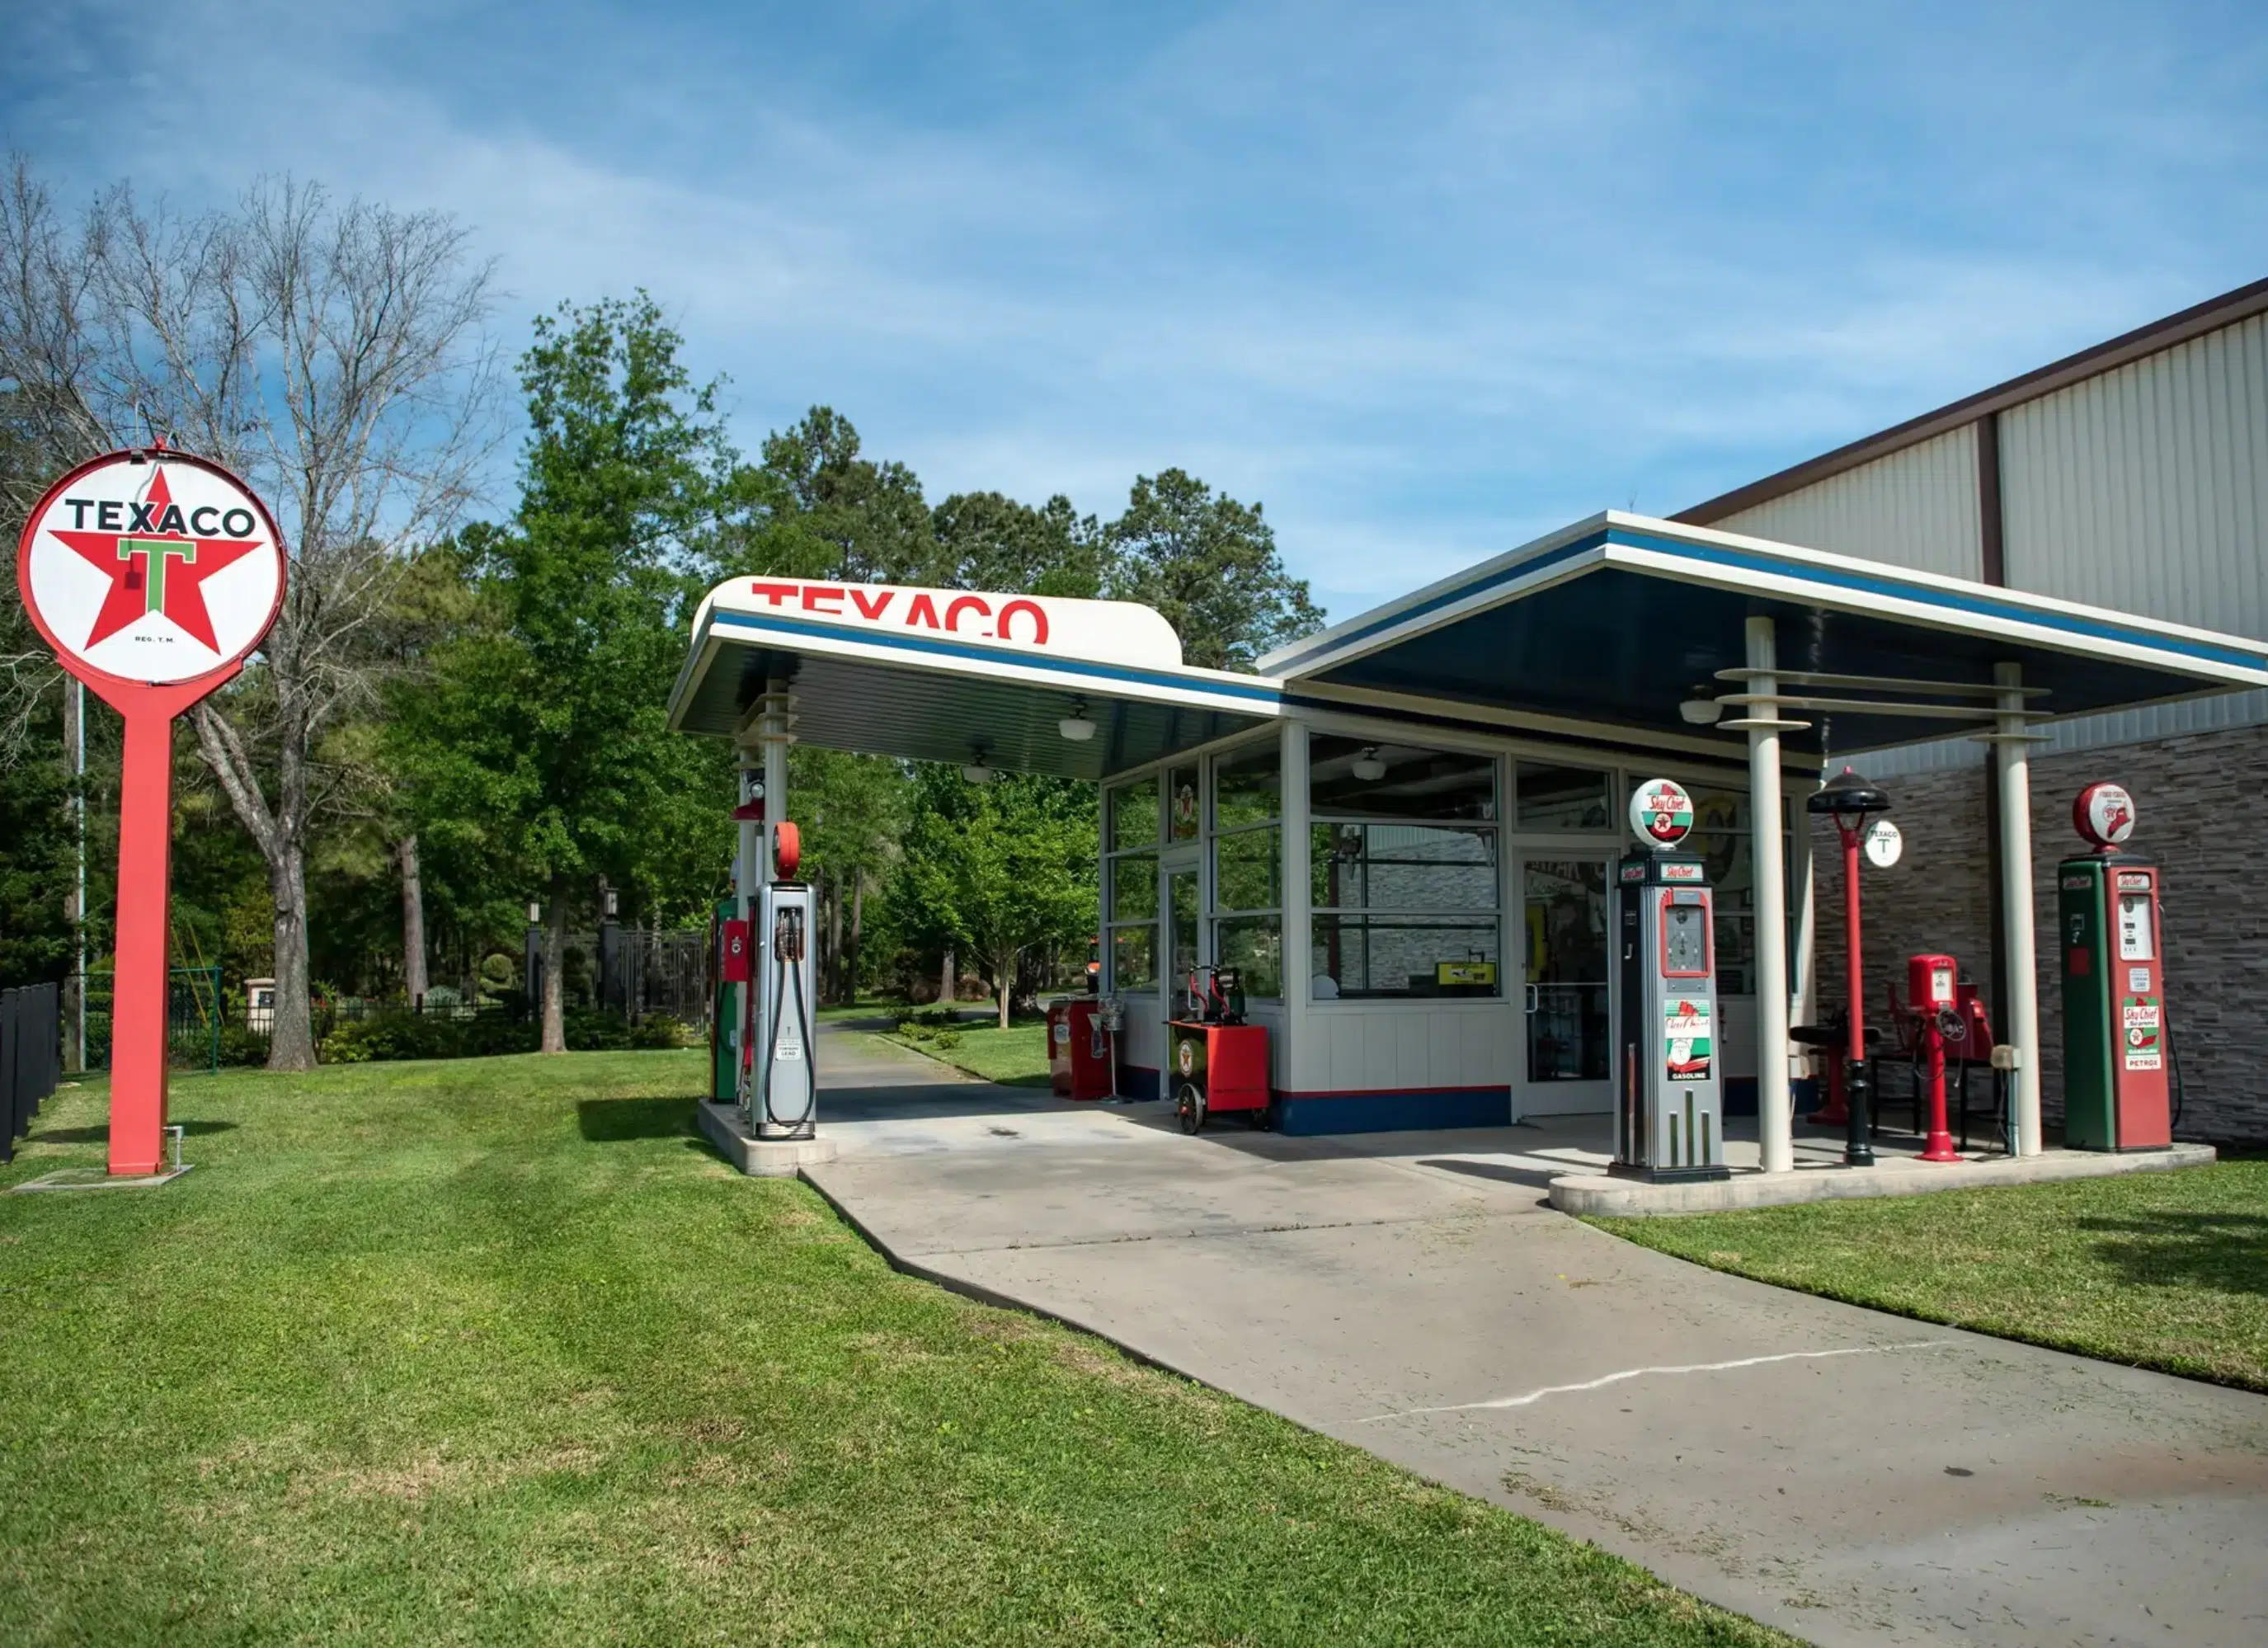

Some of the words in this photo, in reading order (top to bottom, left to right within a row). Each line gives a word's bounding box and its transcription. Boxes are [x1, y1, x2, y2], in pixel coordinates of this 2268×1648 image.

[65, 498, 256, 538] TEXACO
[1650, 796, 1665, 810] Sky
[1667, 796, 1685, 809] Chief
[1668, 866, 1679, 877] Sky
[1679, 865, 1693, 876] Chief
[2125, 1008, 2138, 1019] Sky
[2139, 1007, 2157, 1019] Chief
